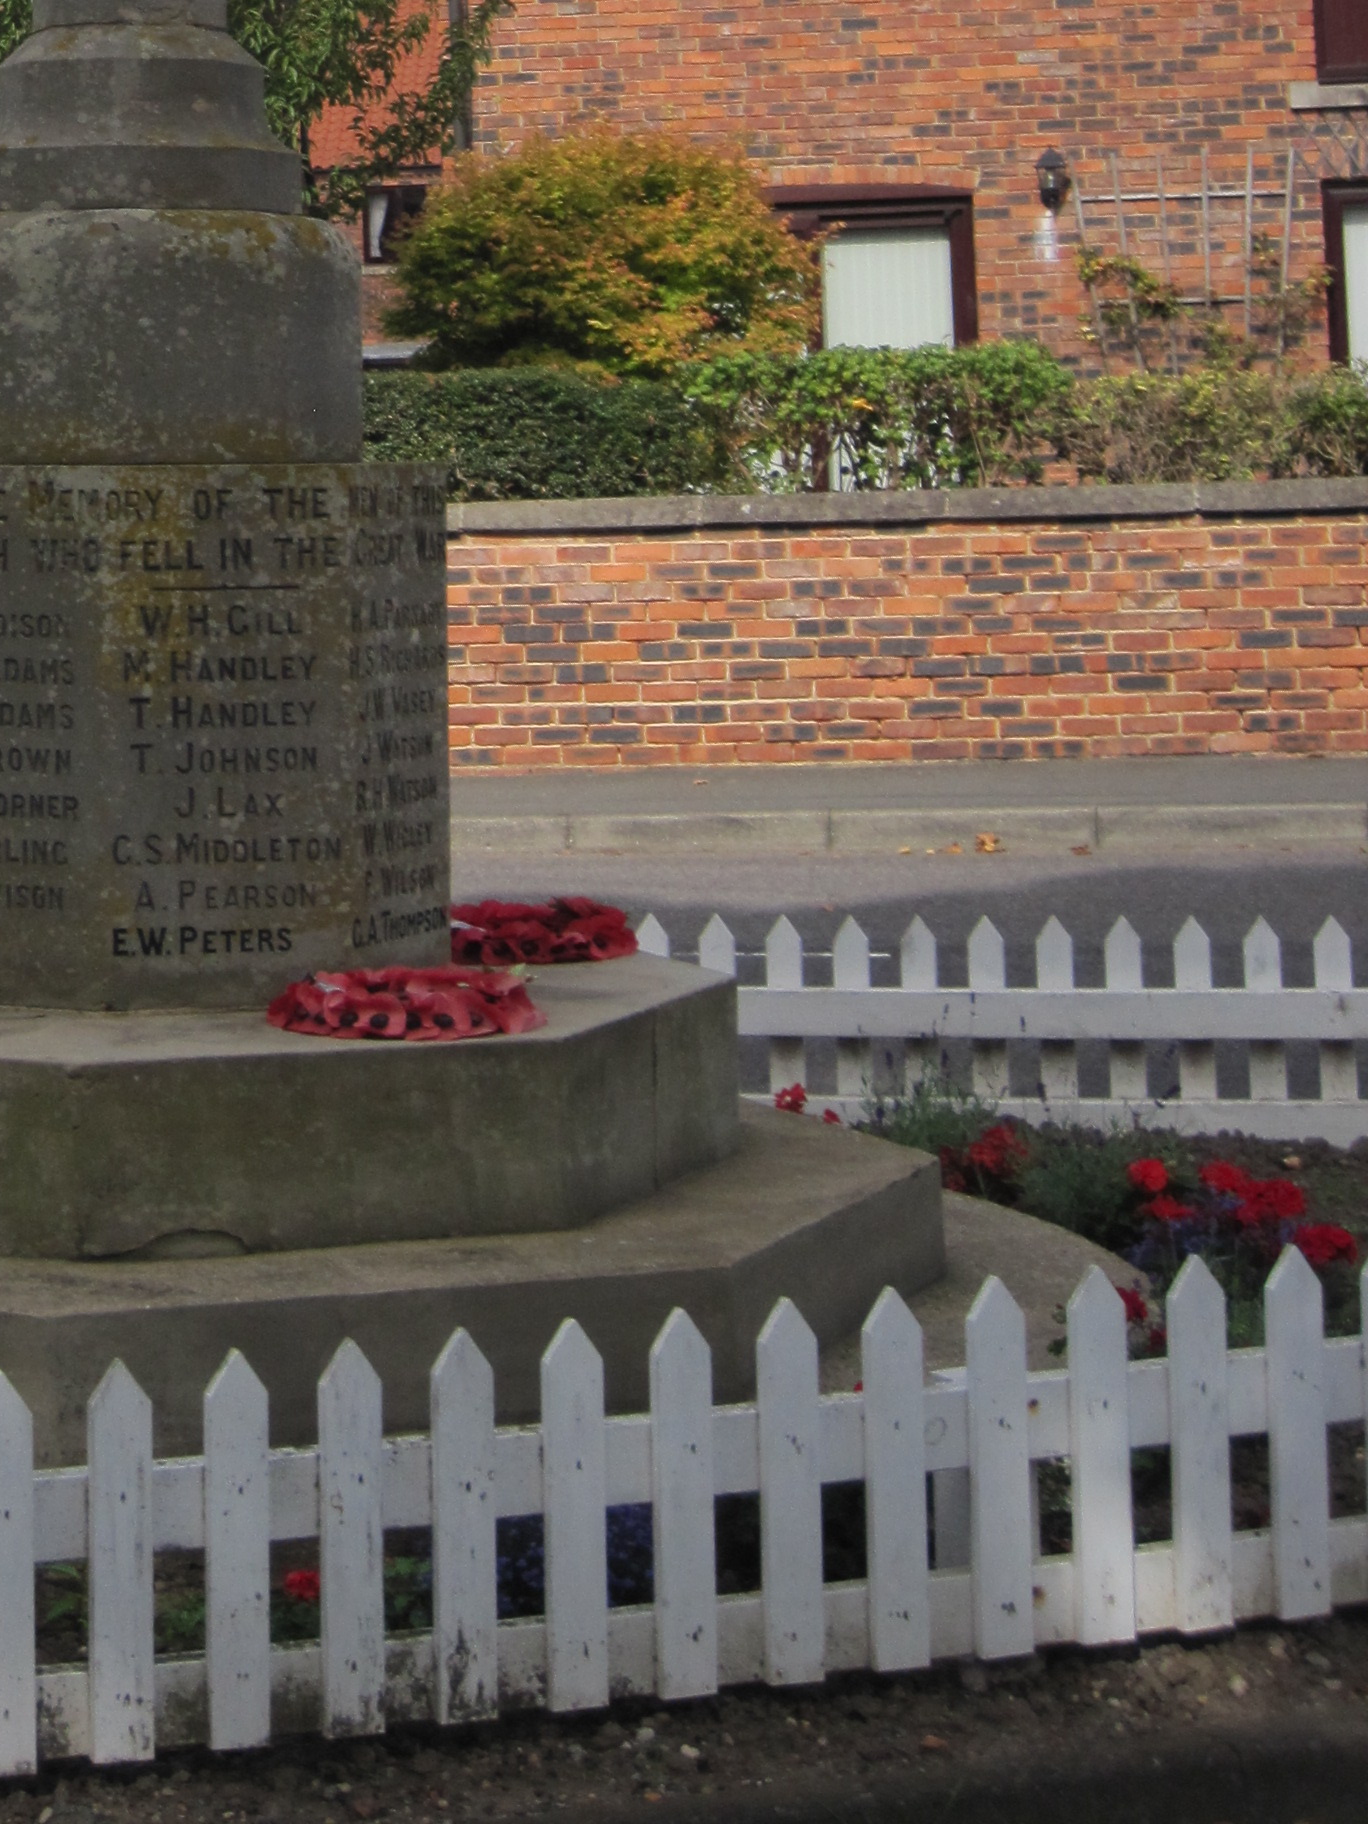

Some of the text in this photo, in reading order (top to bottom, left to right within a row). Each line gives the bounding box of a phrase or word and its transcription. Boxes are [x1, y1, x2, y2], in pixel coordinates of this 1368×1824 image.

[28, 480, 163, 521] MEMORY
[193, 488, 233, 520] OF
[262, 487, 330, 518] THE
[32, 538, 99, 572] WHO
[120, 538, 203, 571] FELL
[220, 538, 252, 570] IN
[273, 537, 341, 567] THE
[175, 741, 318, 774] JOHNSON
[217, 786, 284, 817] LAX
[179, 879, 318, 911] PEARSON
